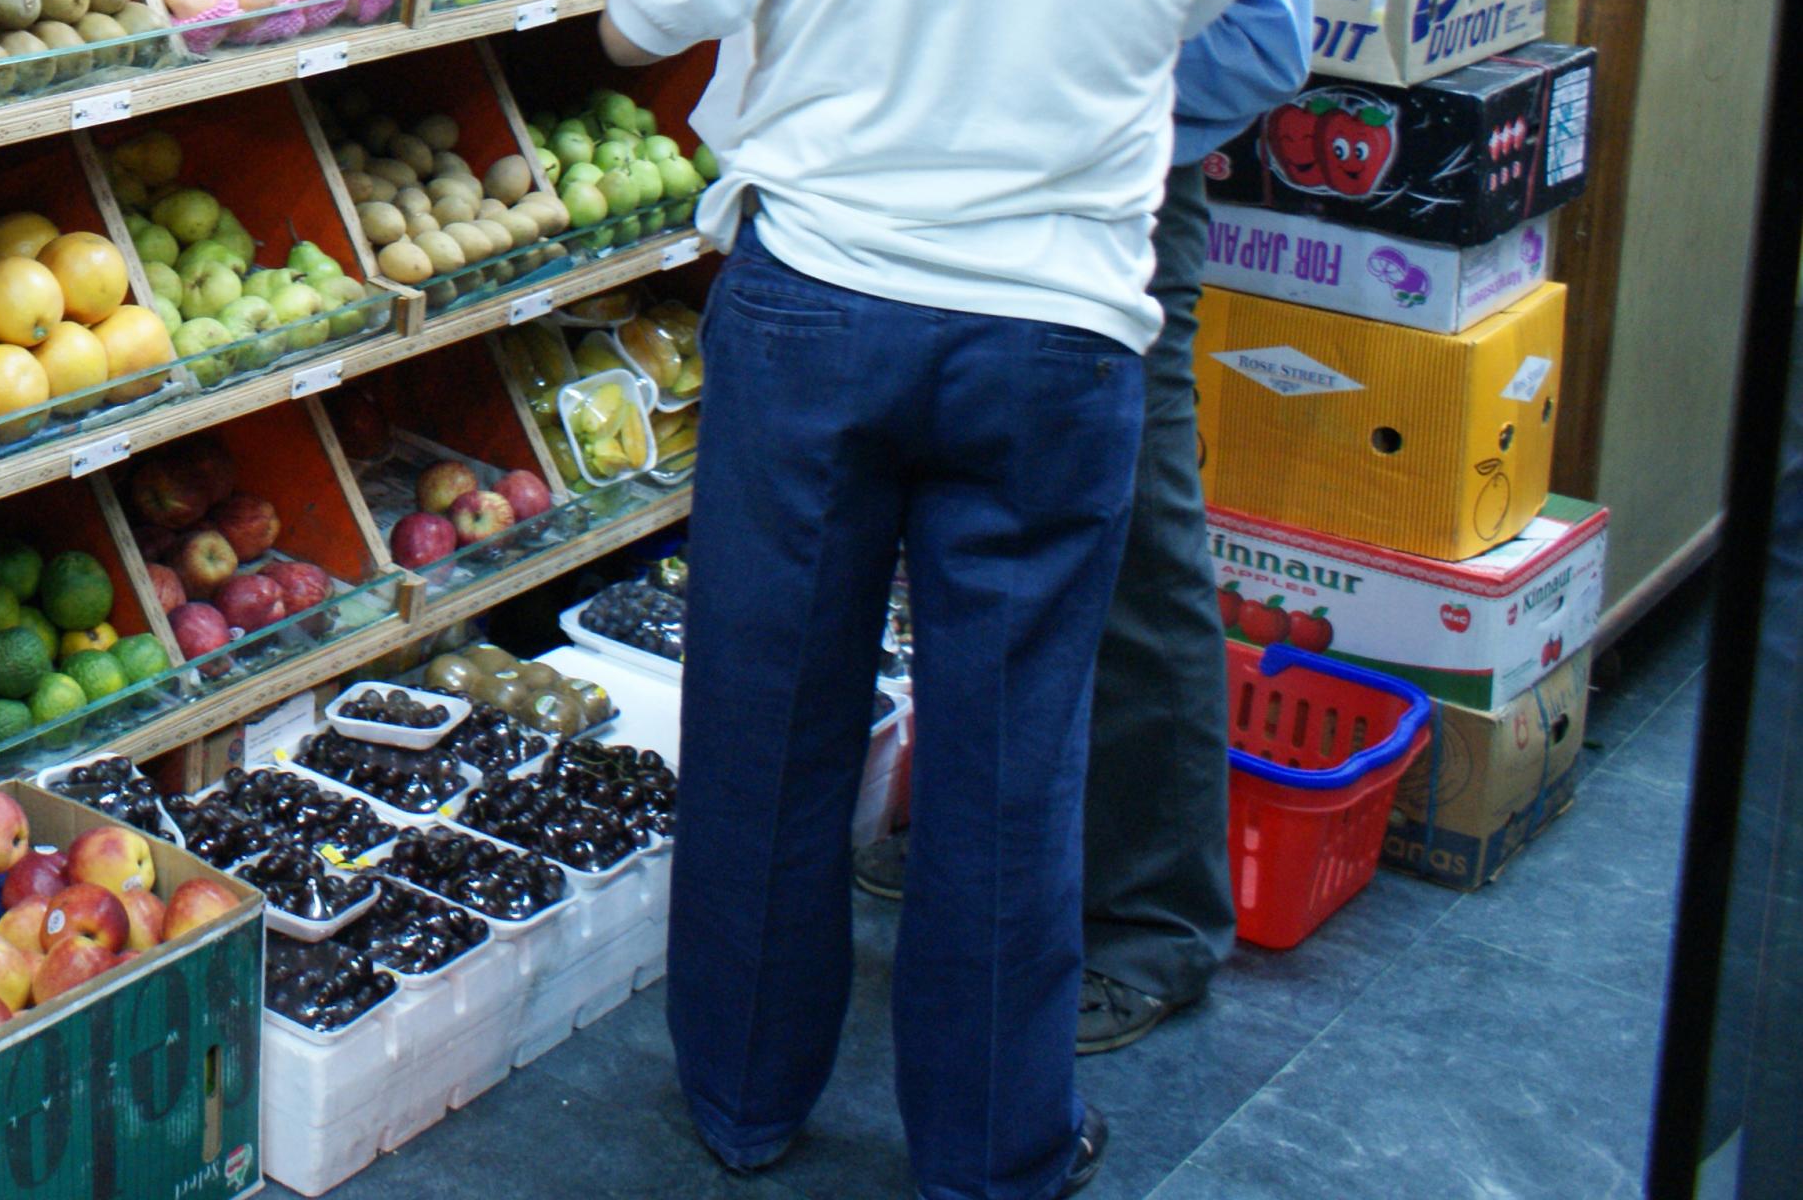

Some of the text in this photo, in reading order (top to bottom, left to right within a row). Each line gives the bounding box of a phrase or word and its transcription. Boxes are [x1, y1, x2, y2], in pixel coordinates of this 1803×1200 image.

[1424, 0, 1506, 66] DUTOIT
[1207, 221, 1343, 286] FOR JAPAN
[1238, 355, 1337, 388] ROSE STREET
[1208, 532, 1363, 594] innaur
[1221, 565, 1318, 597] APPLES
[1523, 566, 1572, 615] Kinnaur
